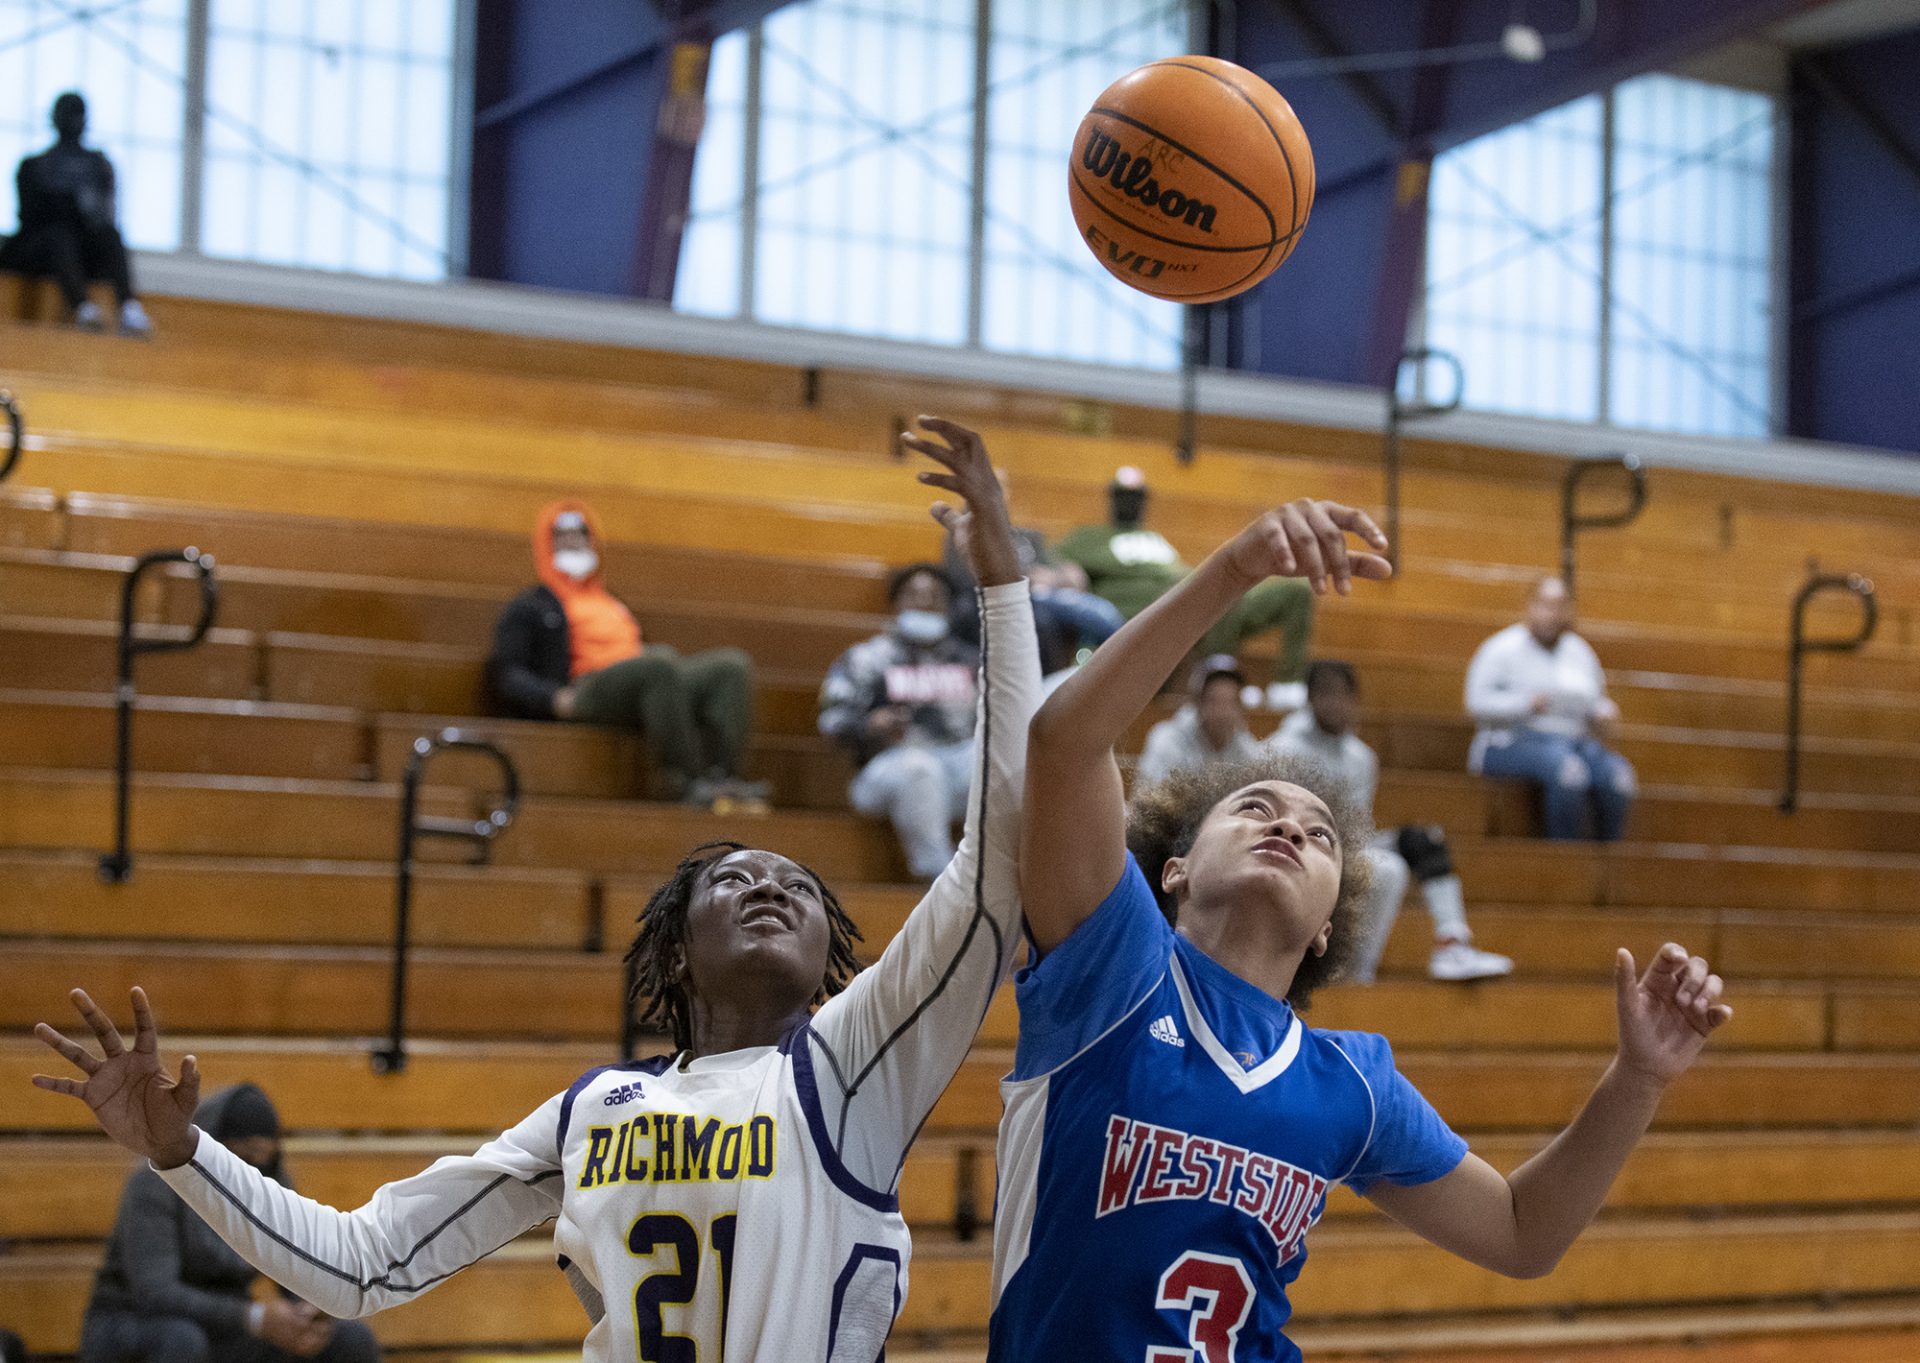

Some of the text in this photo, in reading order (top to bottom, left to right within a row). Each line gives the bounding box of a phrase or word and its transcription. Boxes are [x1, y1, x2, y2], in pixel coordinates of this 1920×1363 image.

[1083, 127, 1217, 233] Wilson
[604, 1089, 646, 1106] adidas
[1096, 1114, 1328, 1269] WESTSIDE
[1146, 1250, 1257, 1363] 3
